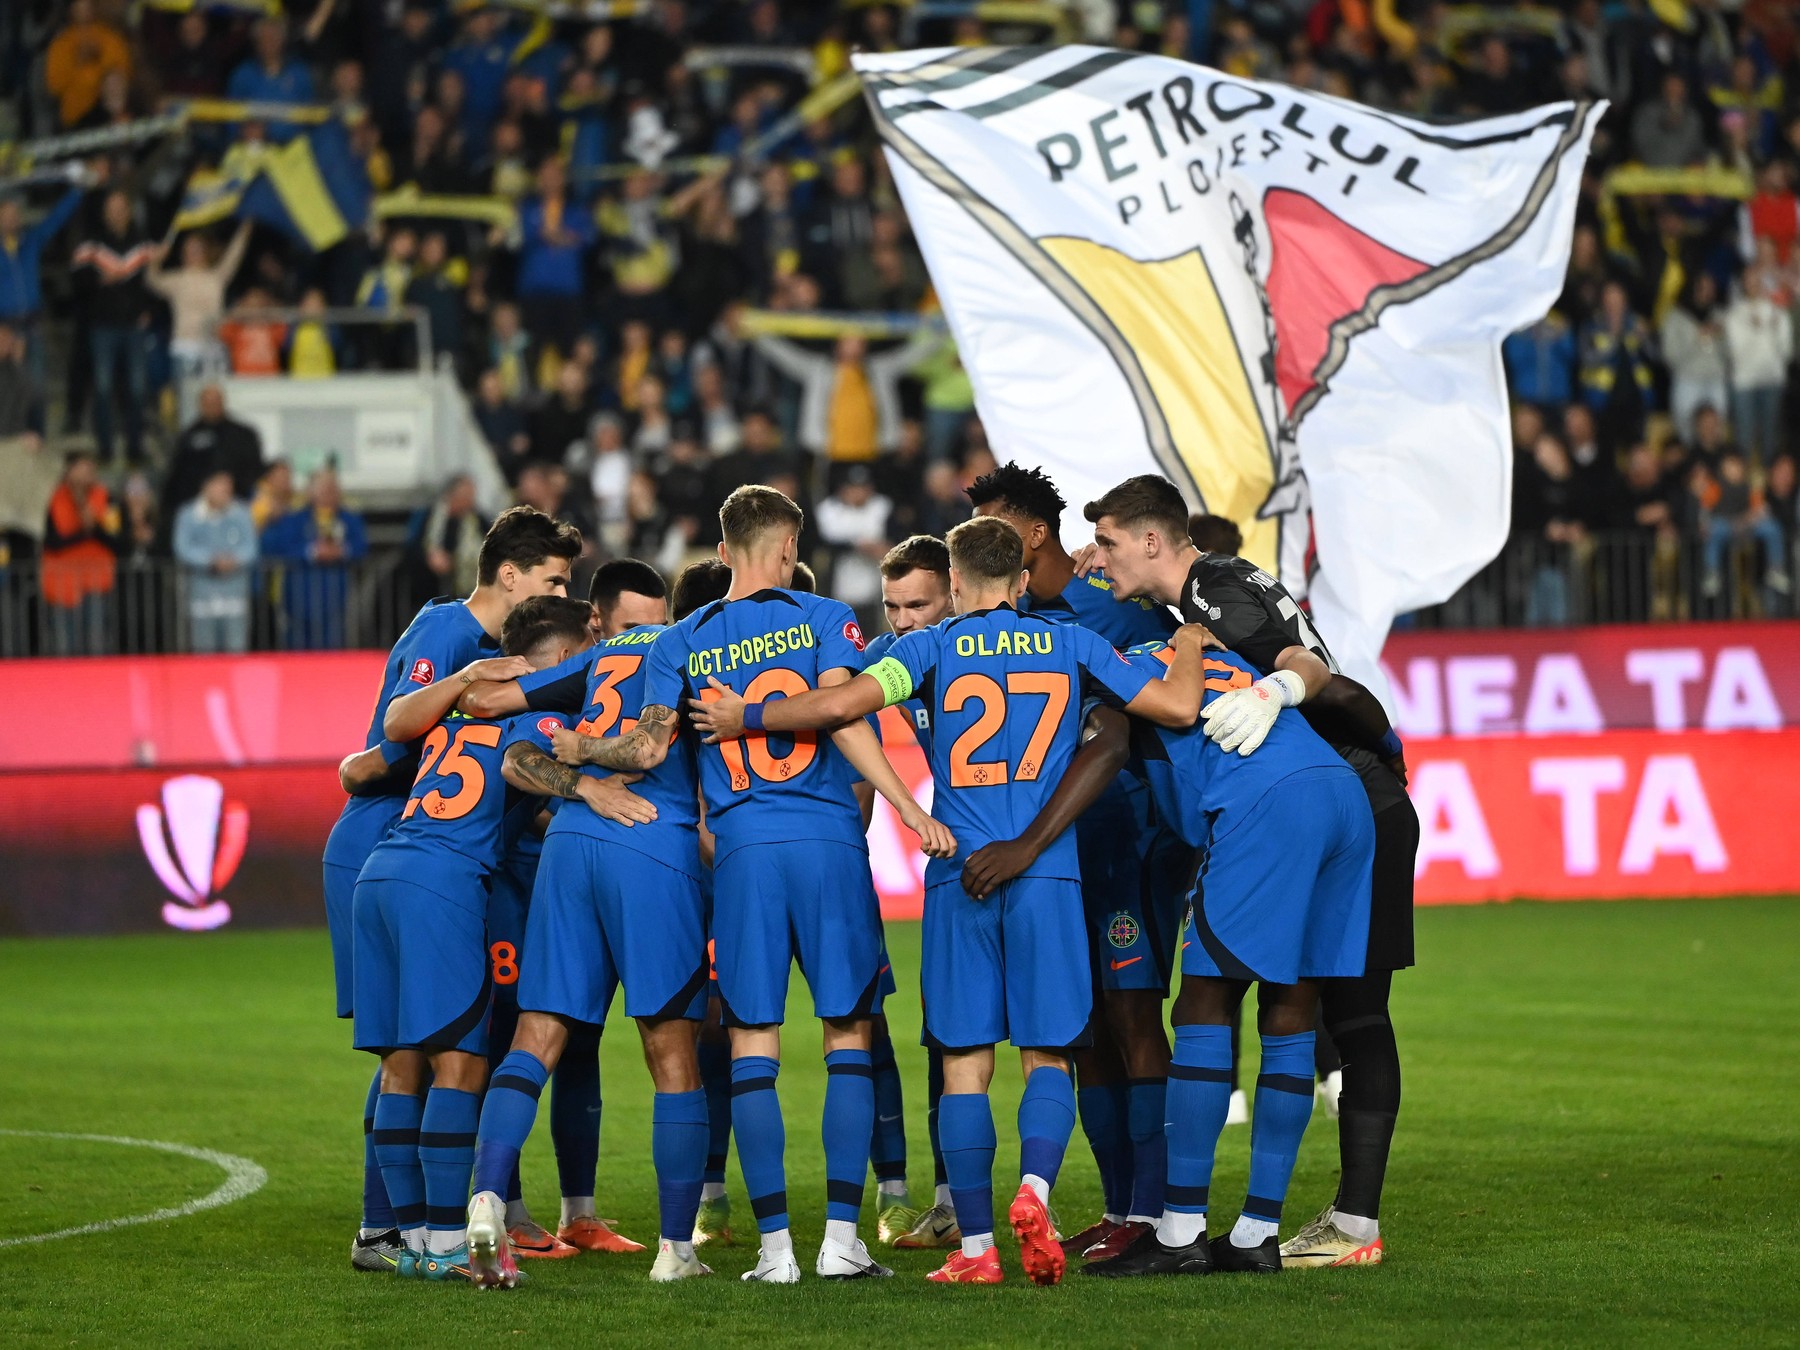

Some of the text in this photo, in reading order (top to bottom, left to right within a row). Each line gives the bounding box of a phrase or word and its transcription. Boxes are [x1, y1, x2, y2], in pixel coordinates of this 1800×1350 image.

[1036, 75, 1428, 195] PETROLUL
[955, 630, 1053, 657] OLARU
[1625, 646, 1784, 732] TA
[400, 723, 502, 822] 25
[942, 671, 1071, 788] 27
[1530, 754, 1729, 876] TA
